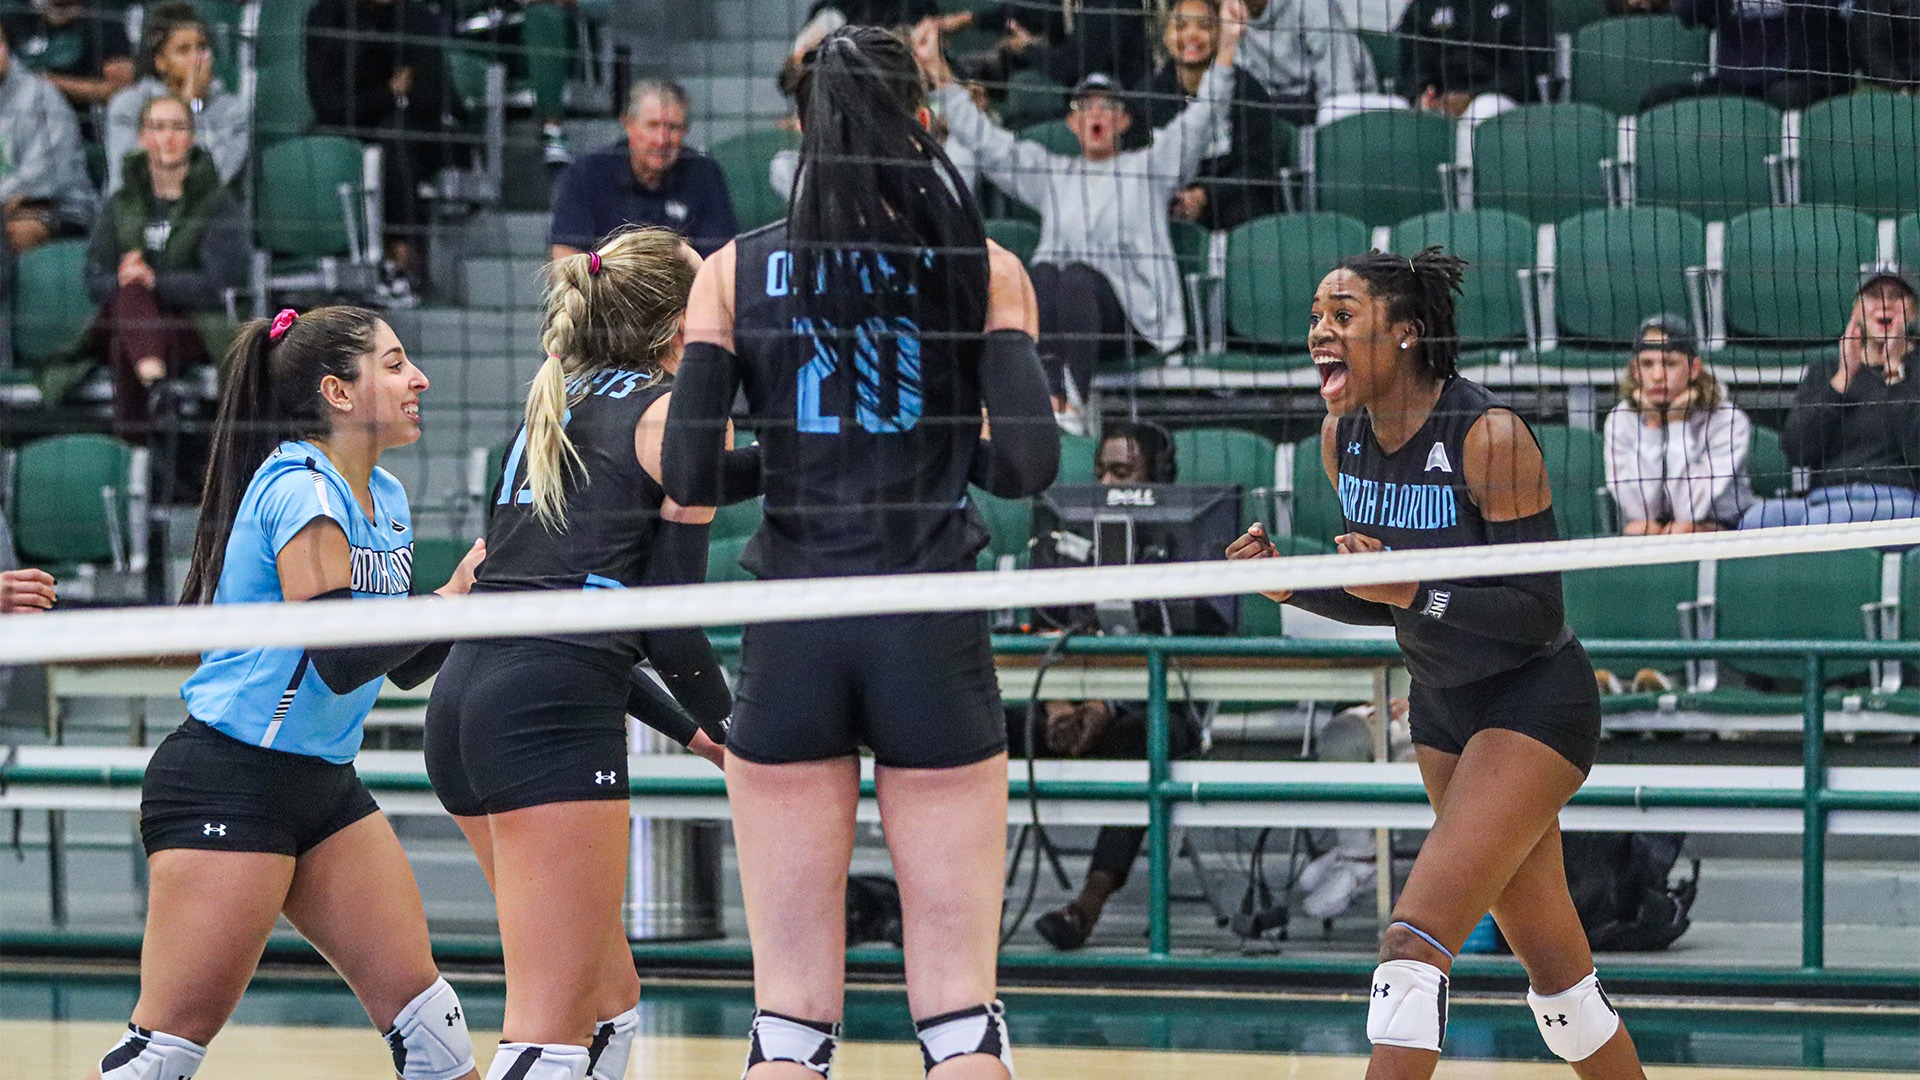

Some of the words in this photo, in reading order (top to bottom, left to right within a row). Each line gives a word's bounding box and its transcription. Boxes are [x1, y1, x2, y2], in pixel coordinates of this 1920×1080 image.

[792, 317, 923, 434] 20
[1106, 488, 1155, 506] DELL
[1338, 472, 1379, 525] NORTH
[1379, 482, 1457, 530] FLORIDA
